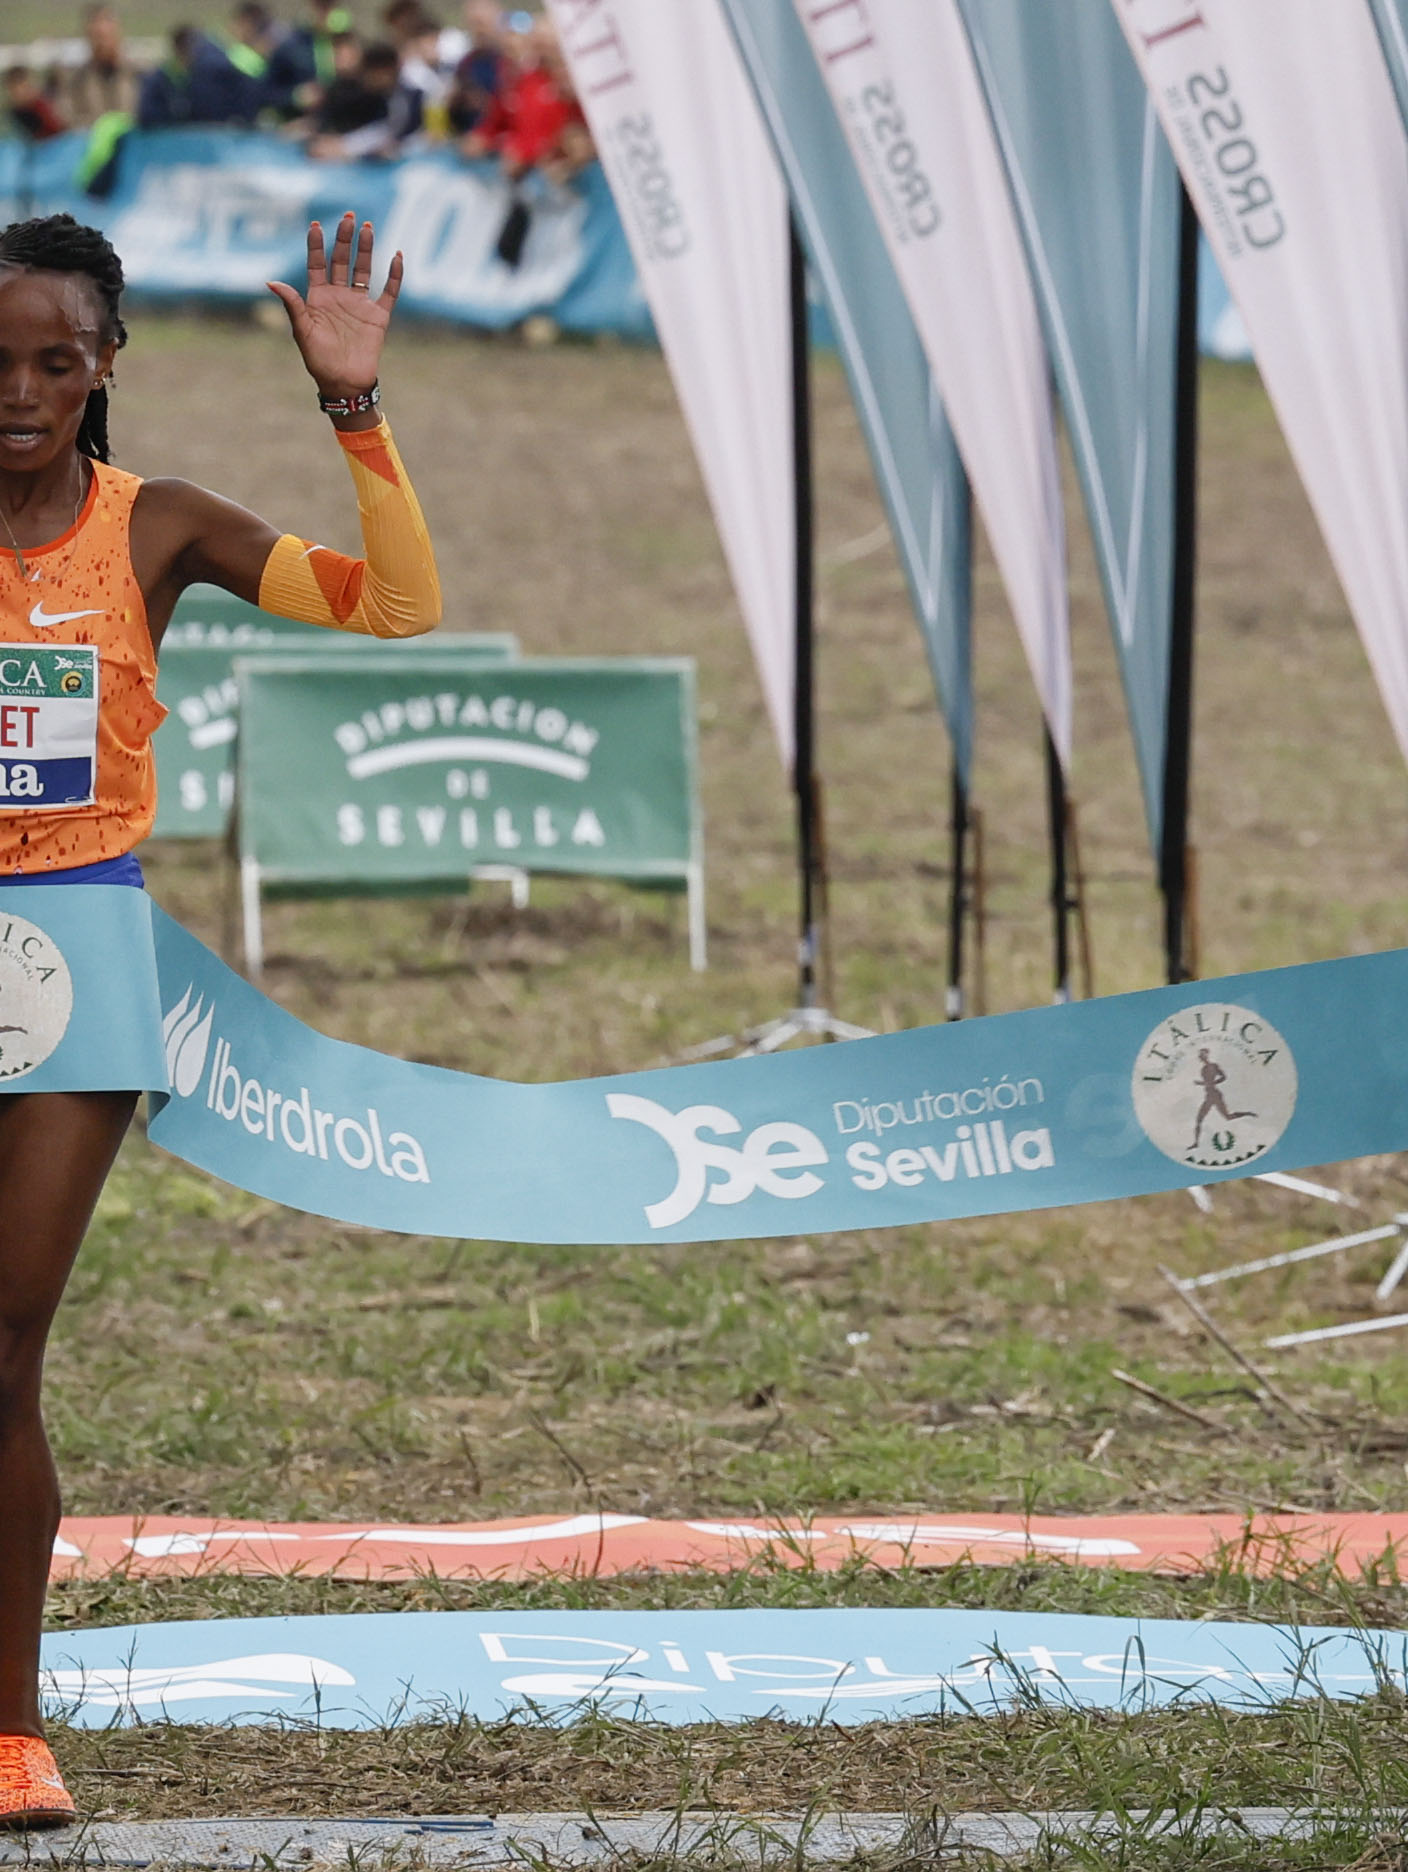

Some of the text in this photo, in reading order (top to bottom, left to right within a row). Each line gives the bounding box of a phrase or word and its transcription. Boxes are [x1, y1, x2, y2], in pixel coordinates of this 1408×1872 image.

[336, 803, 606, 849] SEVILLA
[1143, 1012, 1279, 1082] ITÁLICA
[206, 1036, 431, 1184] Iberdrola
[832, 1073, 1045, 1138] Diputación
[844, 1119, 1055, 1192] Sevilla
